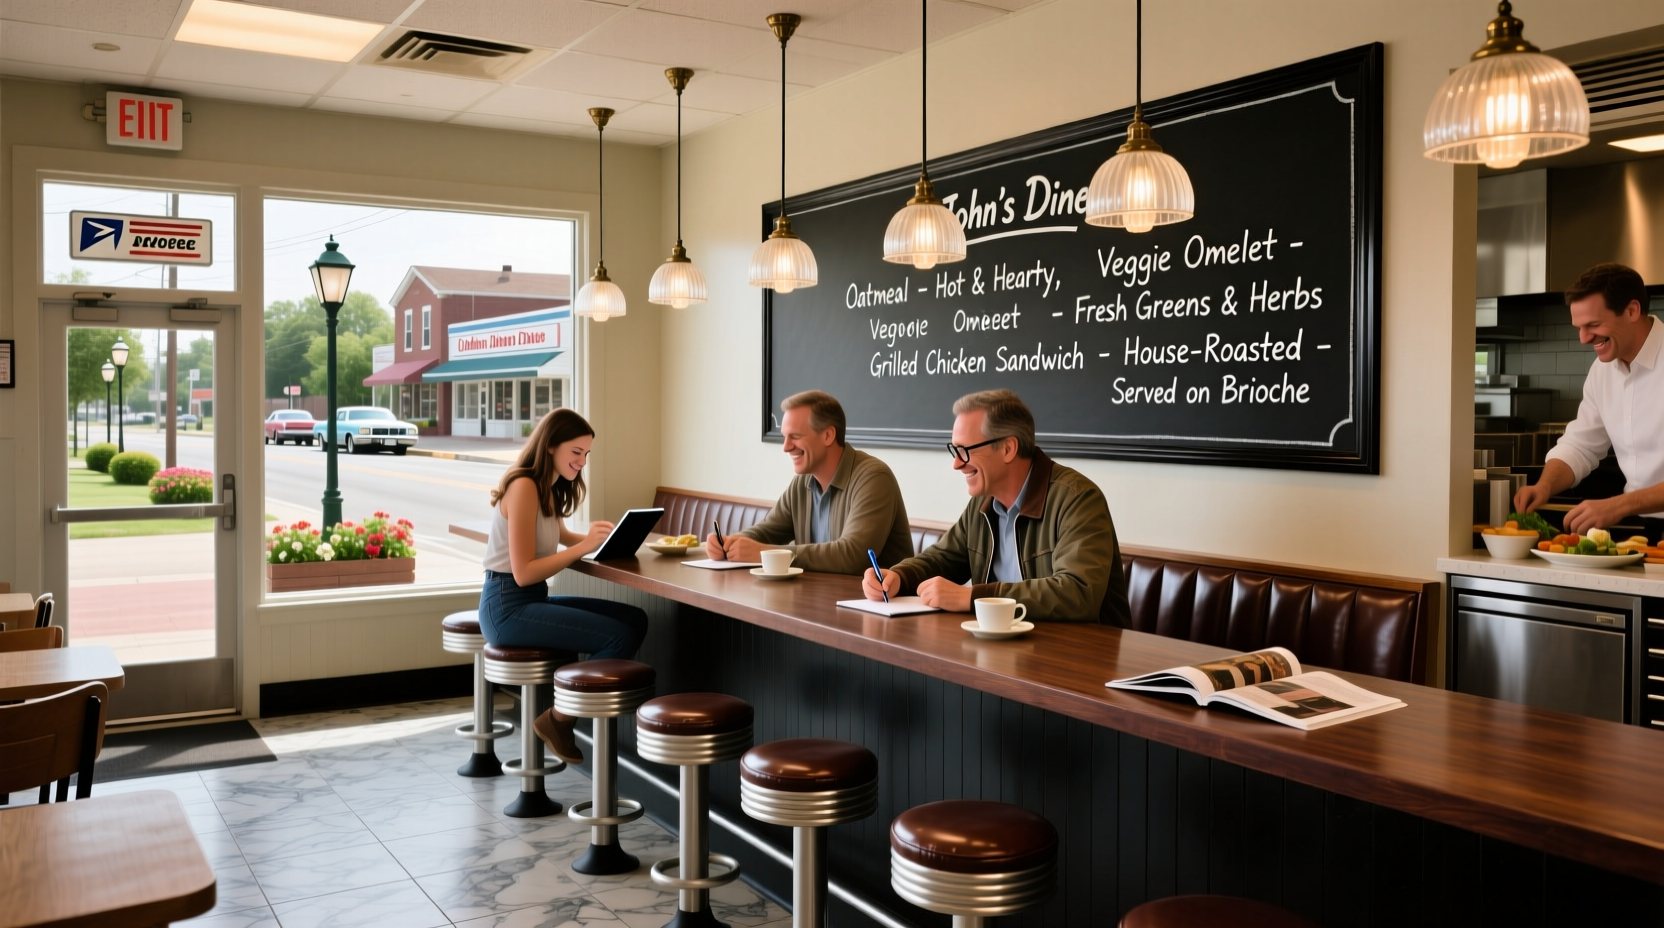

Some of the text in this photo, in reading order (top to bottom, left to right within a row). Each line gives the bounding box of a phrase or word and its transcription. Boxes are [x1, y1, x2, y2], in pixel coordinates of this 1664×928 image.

[942, 175, 1089, 230] John's Dine
[1097, 246, 1171, 288] Veggie
[1184, 229, 1278, 269] Omelet
[845, 282, 909, 310] Oatmeal
[936, 271, 966, 299] Hot
[971, 266, 985, 295] &
[994, 259, 1062, 299] Hearty,
[1075, 293, 1127, 324] Fresh
[1135, 290, 1211, 321] Greens
[1221, 285, 1238, 316] &
[1249, 276, 1323, 313] Herbs
[869, 350, 919, 379] Grilled
[925, 348, 986, 375] Chicken
[995, 341, 1084, 372] Sandwich
[1124, 327, 1304, 366] House-Roasted
[1111, 372, 1310, 405] Served on Brioche
